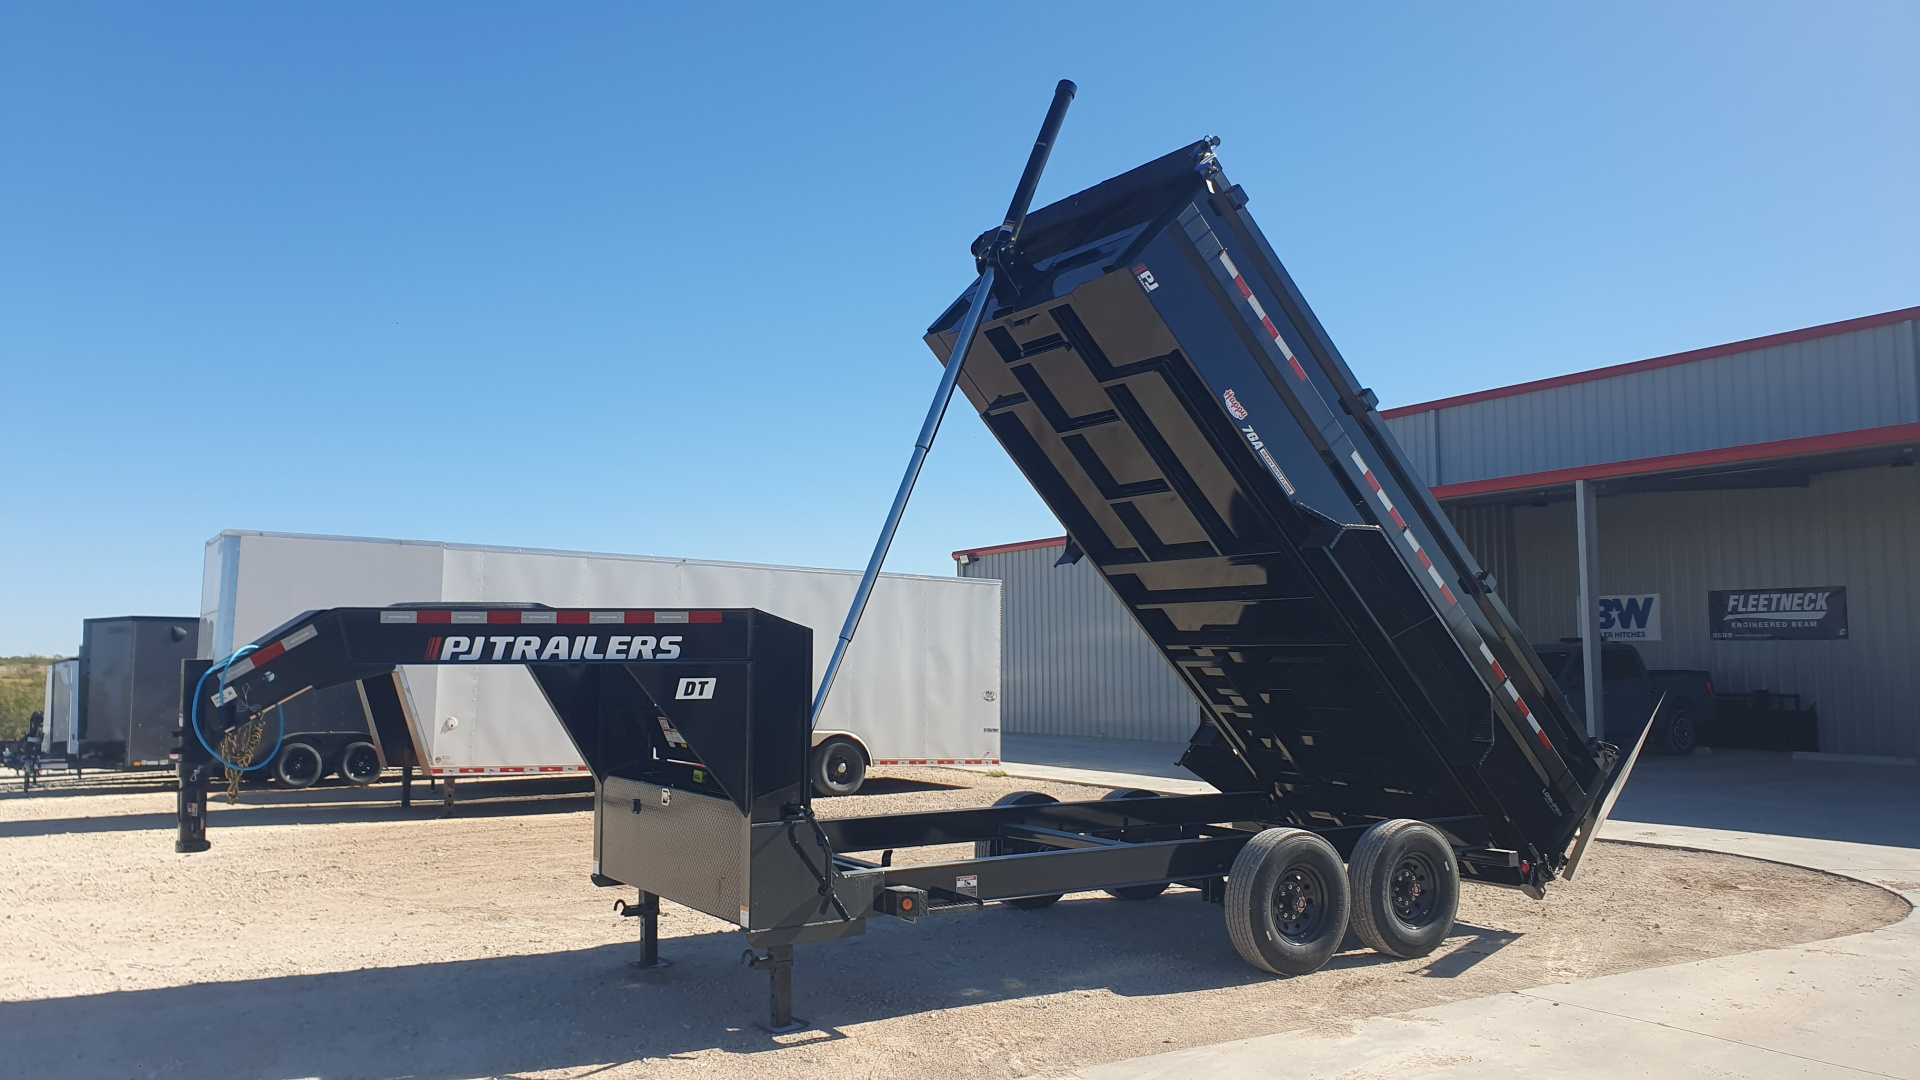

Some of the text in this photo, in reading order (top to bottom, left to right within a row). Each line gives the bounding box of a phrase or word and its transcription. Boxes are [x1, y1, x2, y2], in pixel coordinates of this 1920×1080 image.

[1139, 270, 1160, 291] PJ
[1224, 389, 1248, 420] Happy
[1241, 424, 1264, 451] 7GA
[1727, 591, 1831, 612] FLEETNECK
[1731, 620, 1818, 629] ENGINEERED BEAM
[440, 635, 683, 661] PJ TRAILERS
[683, 681, 709, 697] DT
